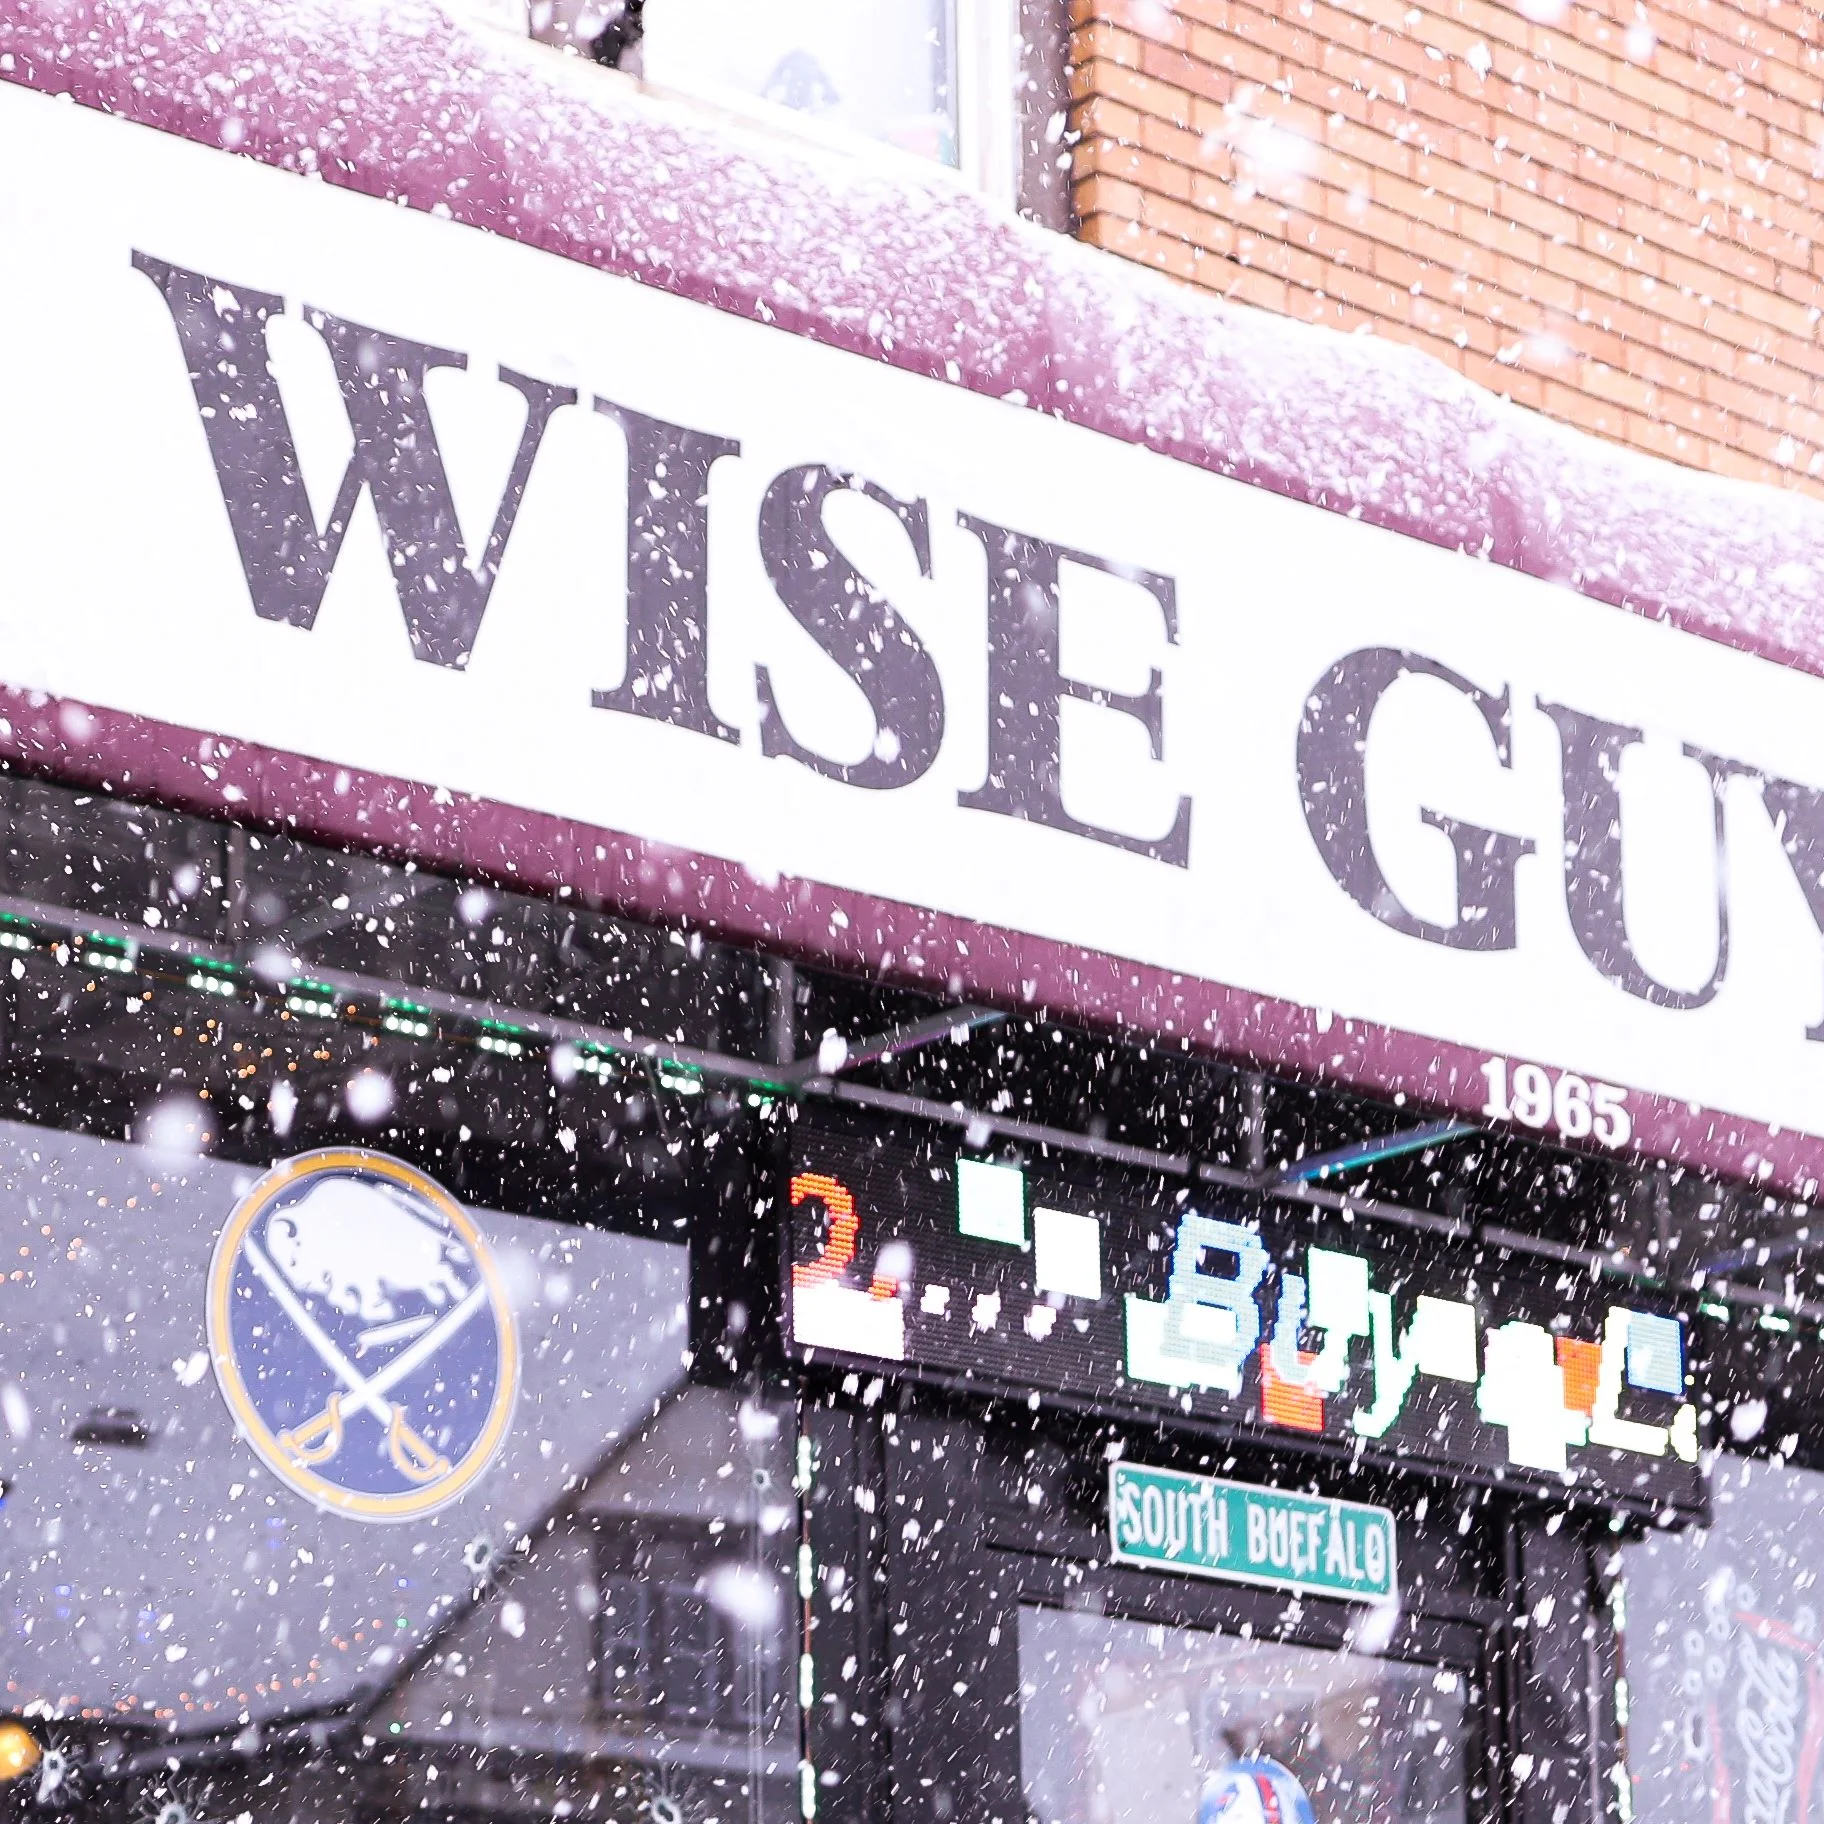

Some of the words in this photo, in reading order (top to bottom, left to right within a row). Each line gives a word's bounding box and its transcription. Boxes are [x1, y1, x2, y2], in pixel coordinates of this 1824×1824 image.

[131, 248, 1193, 869] WISE
[1480, 1056, 1631, 1148] 1965
[1121, 1481, 1228, 1559] SOUTH
[1246, 1502, 1387, 1584] BUFFALO
